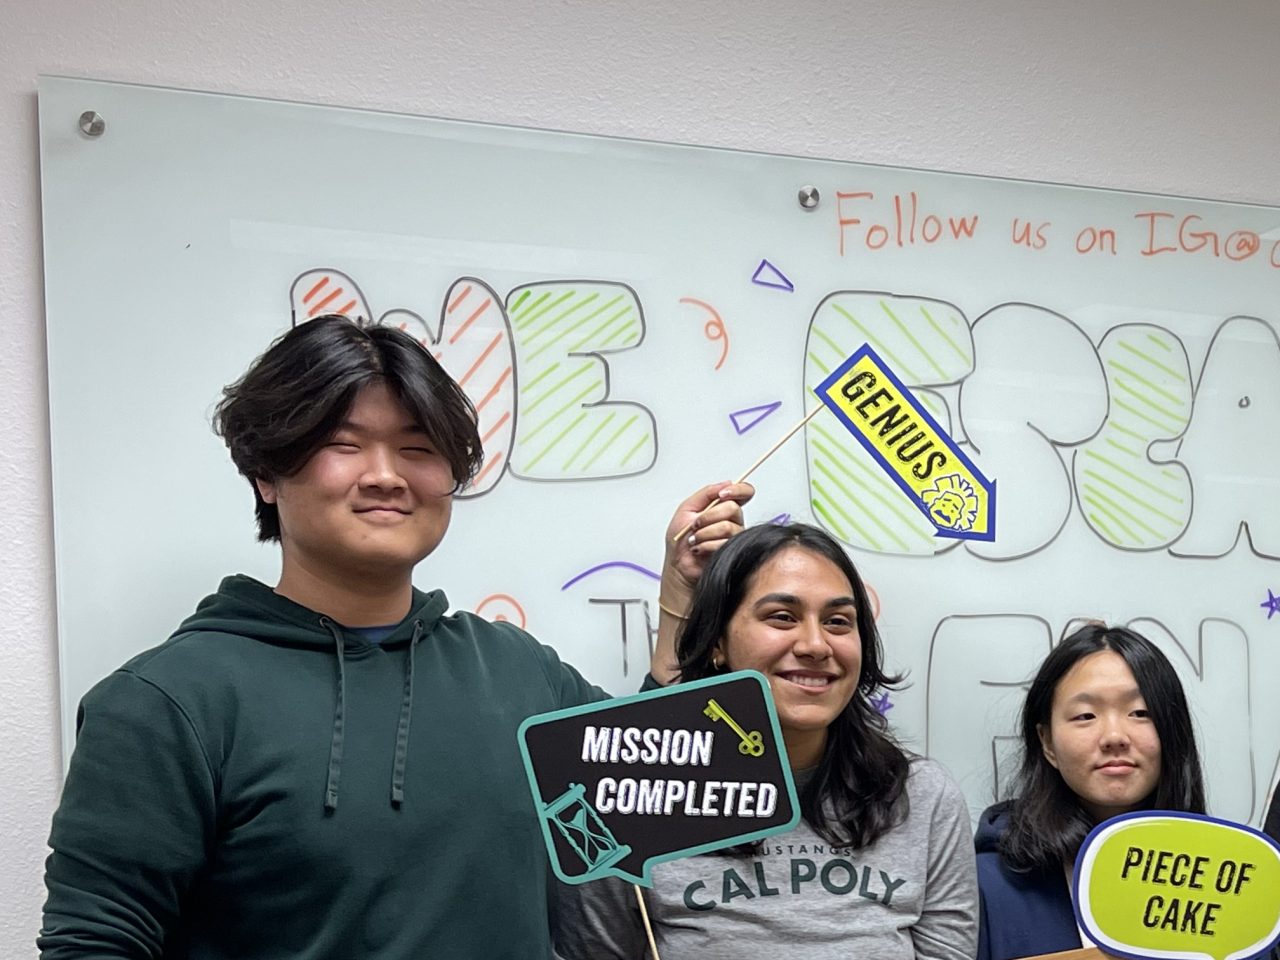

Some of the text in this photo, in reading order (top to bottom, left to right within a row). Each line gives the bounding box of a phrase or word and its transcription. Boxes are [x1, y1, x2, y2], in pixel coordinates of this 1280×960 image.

[836, 191, 979, 257] Follow
[1011, 217, 1052, 250] us
[1075, 226, 1117, 256] on
[840, 370, 948, 480] GENIUS
[580, 725, 715, 767] MISSION
[595, 776, 779, 819] COMPLETED
[758, 844, 851, 857] USTANGS
[1120, 846, 1256, 896] PIECE OF
[682, 857, 907, 912] CAL POLY
[1142, 895, 1222, 937] CAKE
